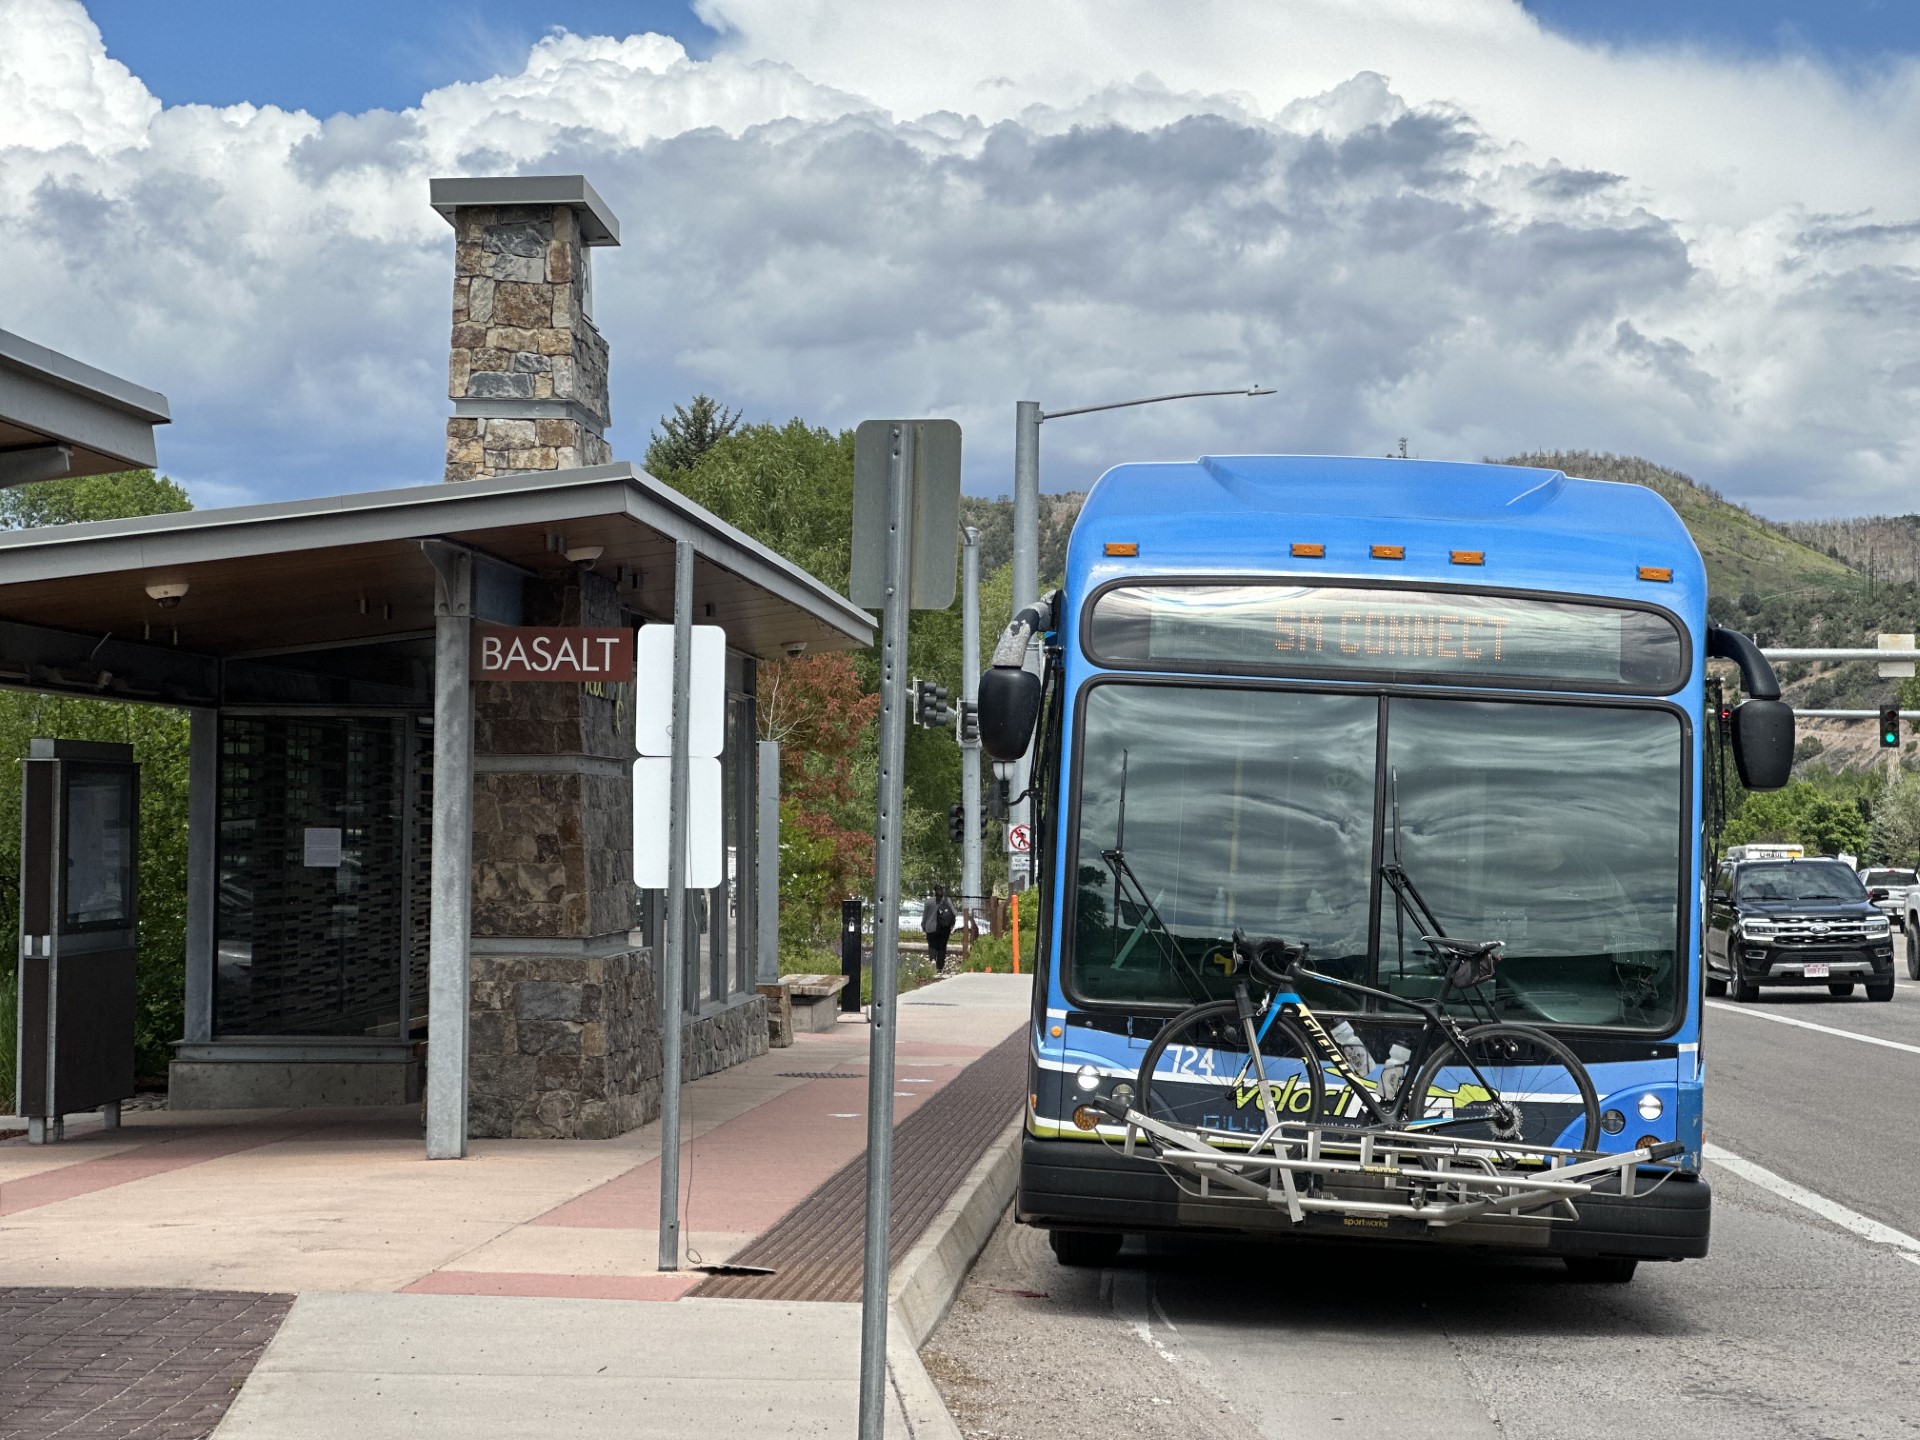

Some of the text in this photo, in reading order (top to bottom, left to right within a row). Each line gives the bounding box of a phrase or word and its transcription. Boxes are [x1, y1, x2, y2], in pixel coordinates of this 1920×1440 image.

[1275, 607, 1510, 660] SM CONNECT
[482, 636, 620, 671] BASALT
[1166, 1045, 1215, 1076] 724
[1343, 1218, 1389, 1228] sportworks
